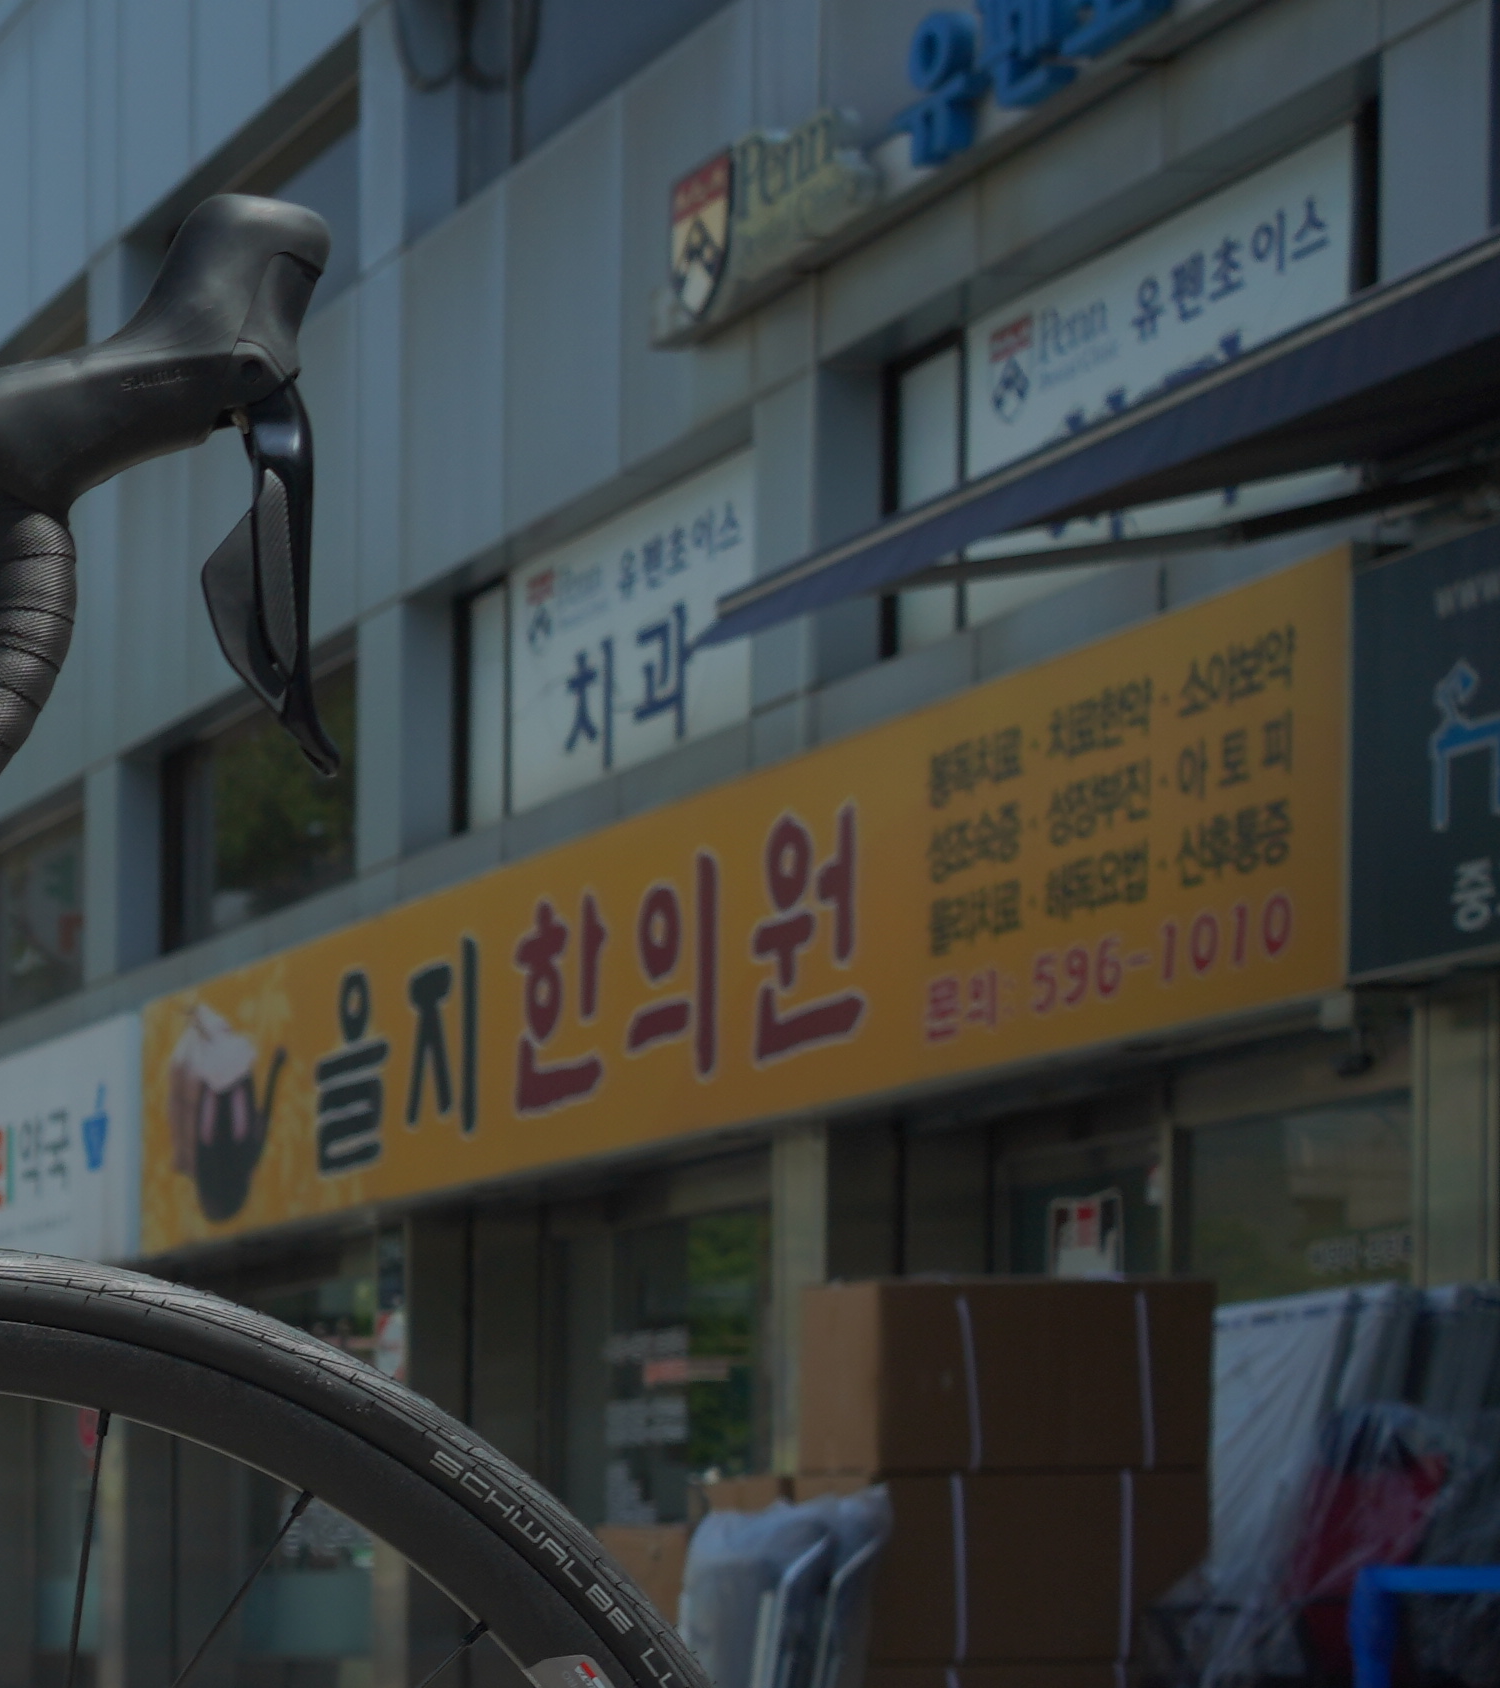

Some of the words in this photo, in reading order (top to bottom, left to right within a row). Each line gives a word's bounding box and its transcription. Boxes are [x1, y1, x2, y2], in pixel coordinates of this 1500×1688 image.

[565, 601, 687, 770] 치과
[1032, 894, 1293, 1014] 596-1010
[429, 1450, 634, 1635] SCHWALBE
